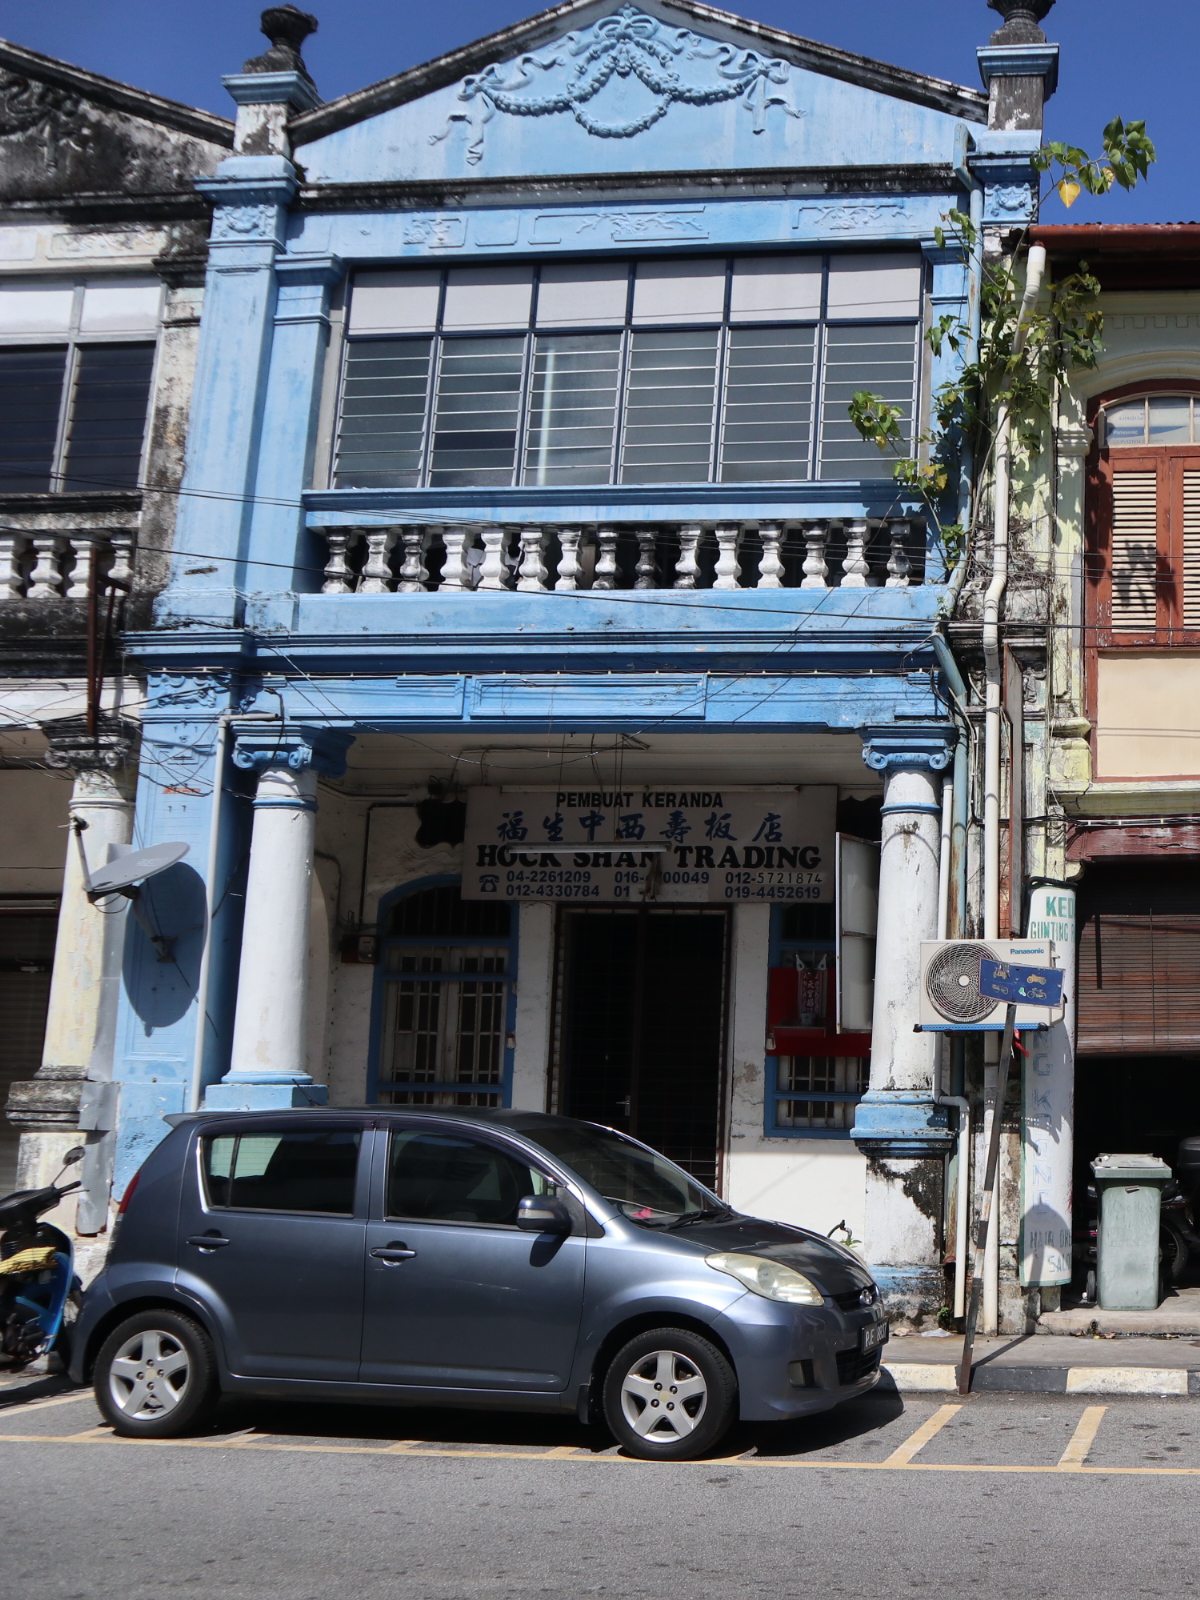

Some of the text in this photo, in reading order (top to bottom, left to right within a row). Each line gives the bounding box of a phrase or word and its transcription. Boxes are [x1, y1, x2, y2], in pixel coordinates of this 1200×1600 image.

[556, 792, 724, 809] PEMBUAT KERANDA
[475, 844, 562, 868] HOCK
[673, 845, 822, 870] TRADING
[506, 870, 823, 885] 04-2261209 016-00049 012-5721874
[505, 884, 600, 897] 012-4330784
[724, 886, 822, 899] 019-4452619
[1030, 921, 1069, 942] GUNTING
[1009, 947, 1045, 955] Panasonic
